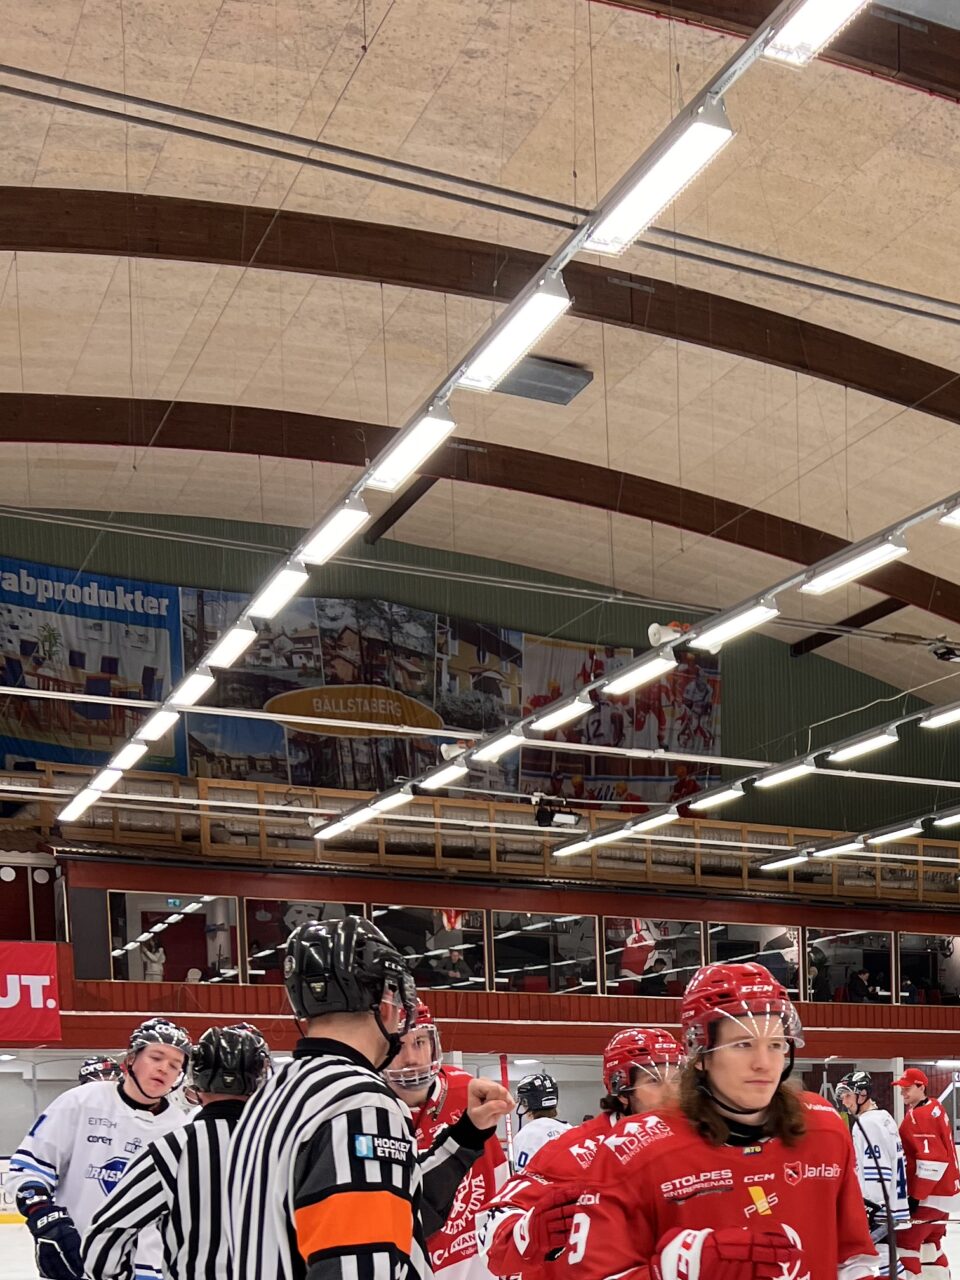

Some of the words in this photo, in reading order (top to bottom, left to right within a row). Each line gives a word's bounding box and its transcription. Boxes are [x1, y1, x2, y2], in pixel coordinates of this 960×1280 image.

[0, 569, 169, 616] abprodukter
[740, 985, 773, 993] CCM
[374, 1138, 410, 1151] HOCKEY
[614, 1122, 671, 1160] LIDENS
[923, 1139, 930, 1154] 1
[377, 1148, 406, 1161] ETTAN
[660, 1169, 733, 1193] STOLPES
[744, 1173, 775, 1183] CCM
[568, 1213, 591, 1265] 9
